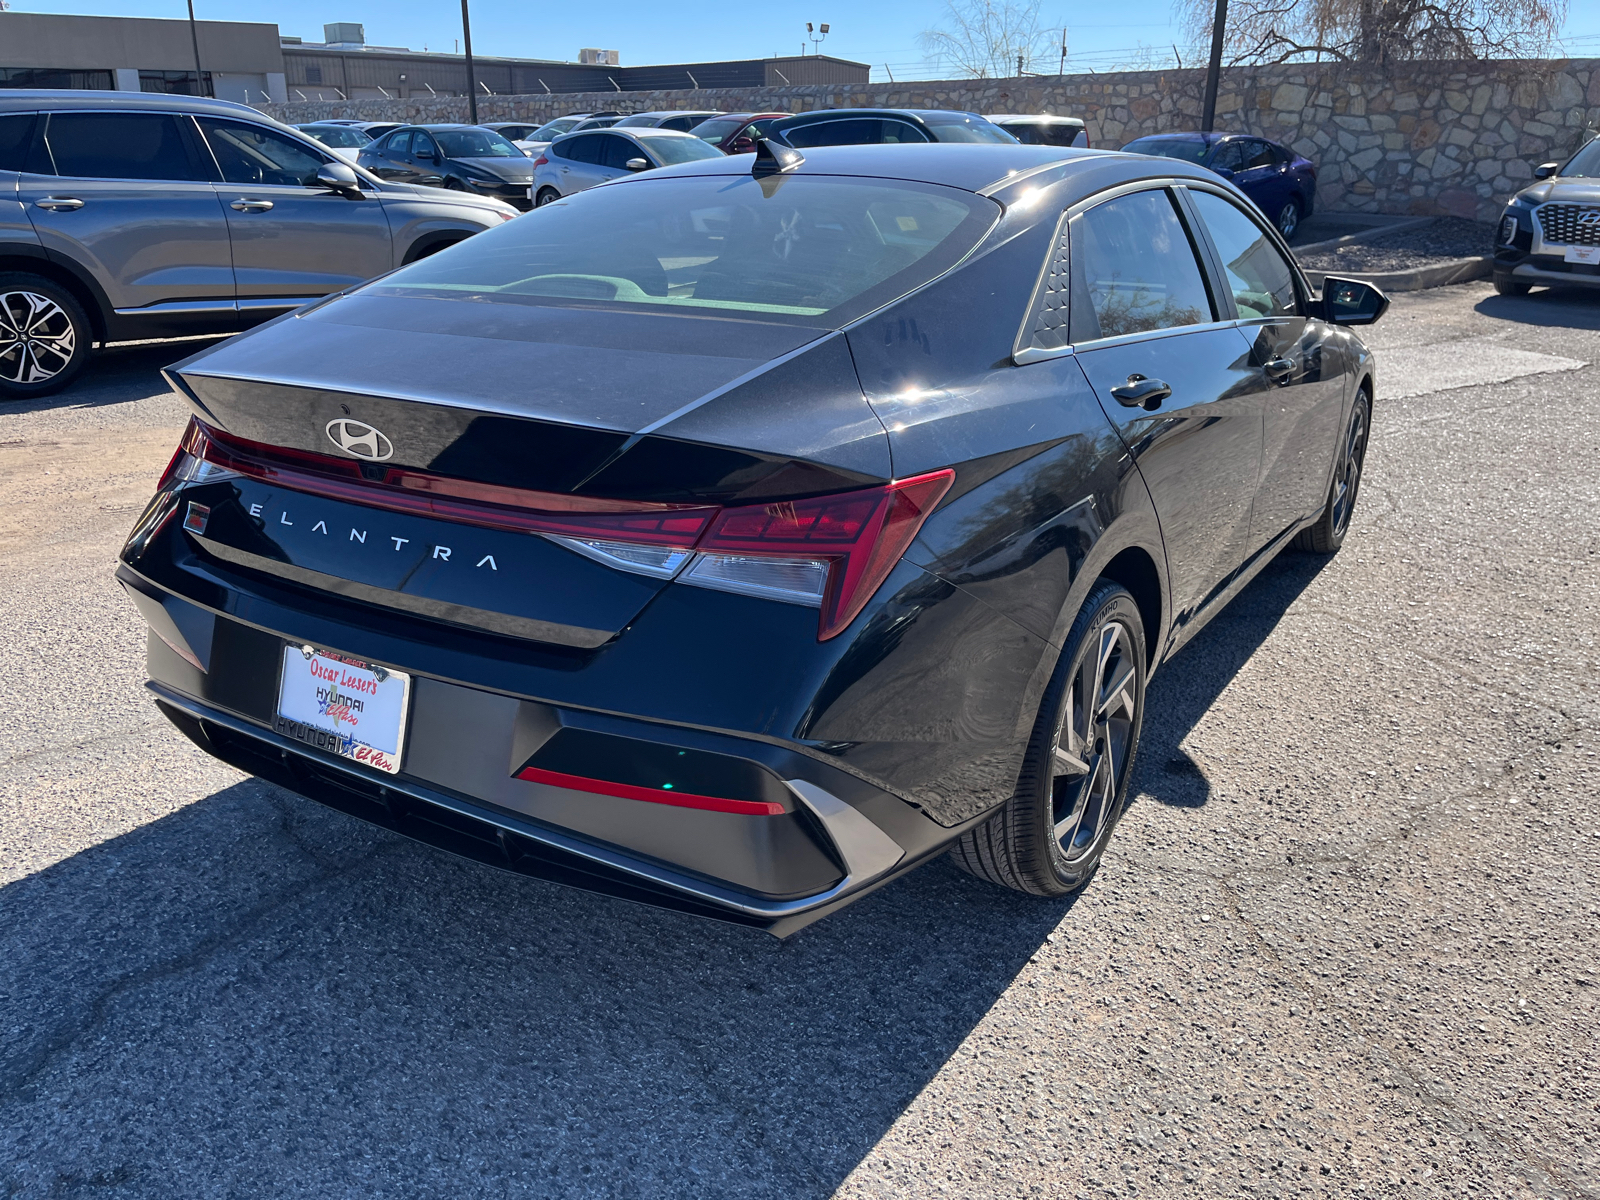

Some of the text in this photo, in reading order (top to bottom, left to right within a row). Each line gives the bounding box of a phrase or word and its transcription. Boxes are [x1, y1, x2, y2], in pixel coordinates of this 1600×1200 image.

[249, 503, 498, 571] ELANTRA
[1091, 600, 1118, 633] KUMHO
[310, 658, 378, 696] Oscar Leeser's
[316, 686, 364, 713] HYUNDAI
[326, 703, 343, 716] El
[337, 705, 359, 726] Paso
[277, 721, 342, 754] HYUNDAI
[355, 747, 372, 760] El
[370, 751, 393, 771] Paso
